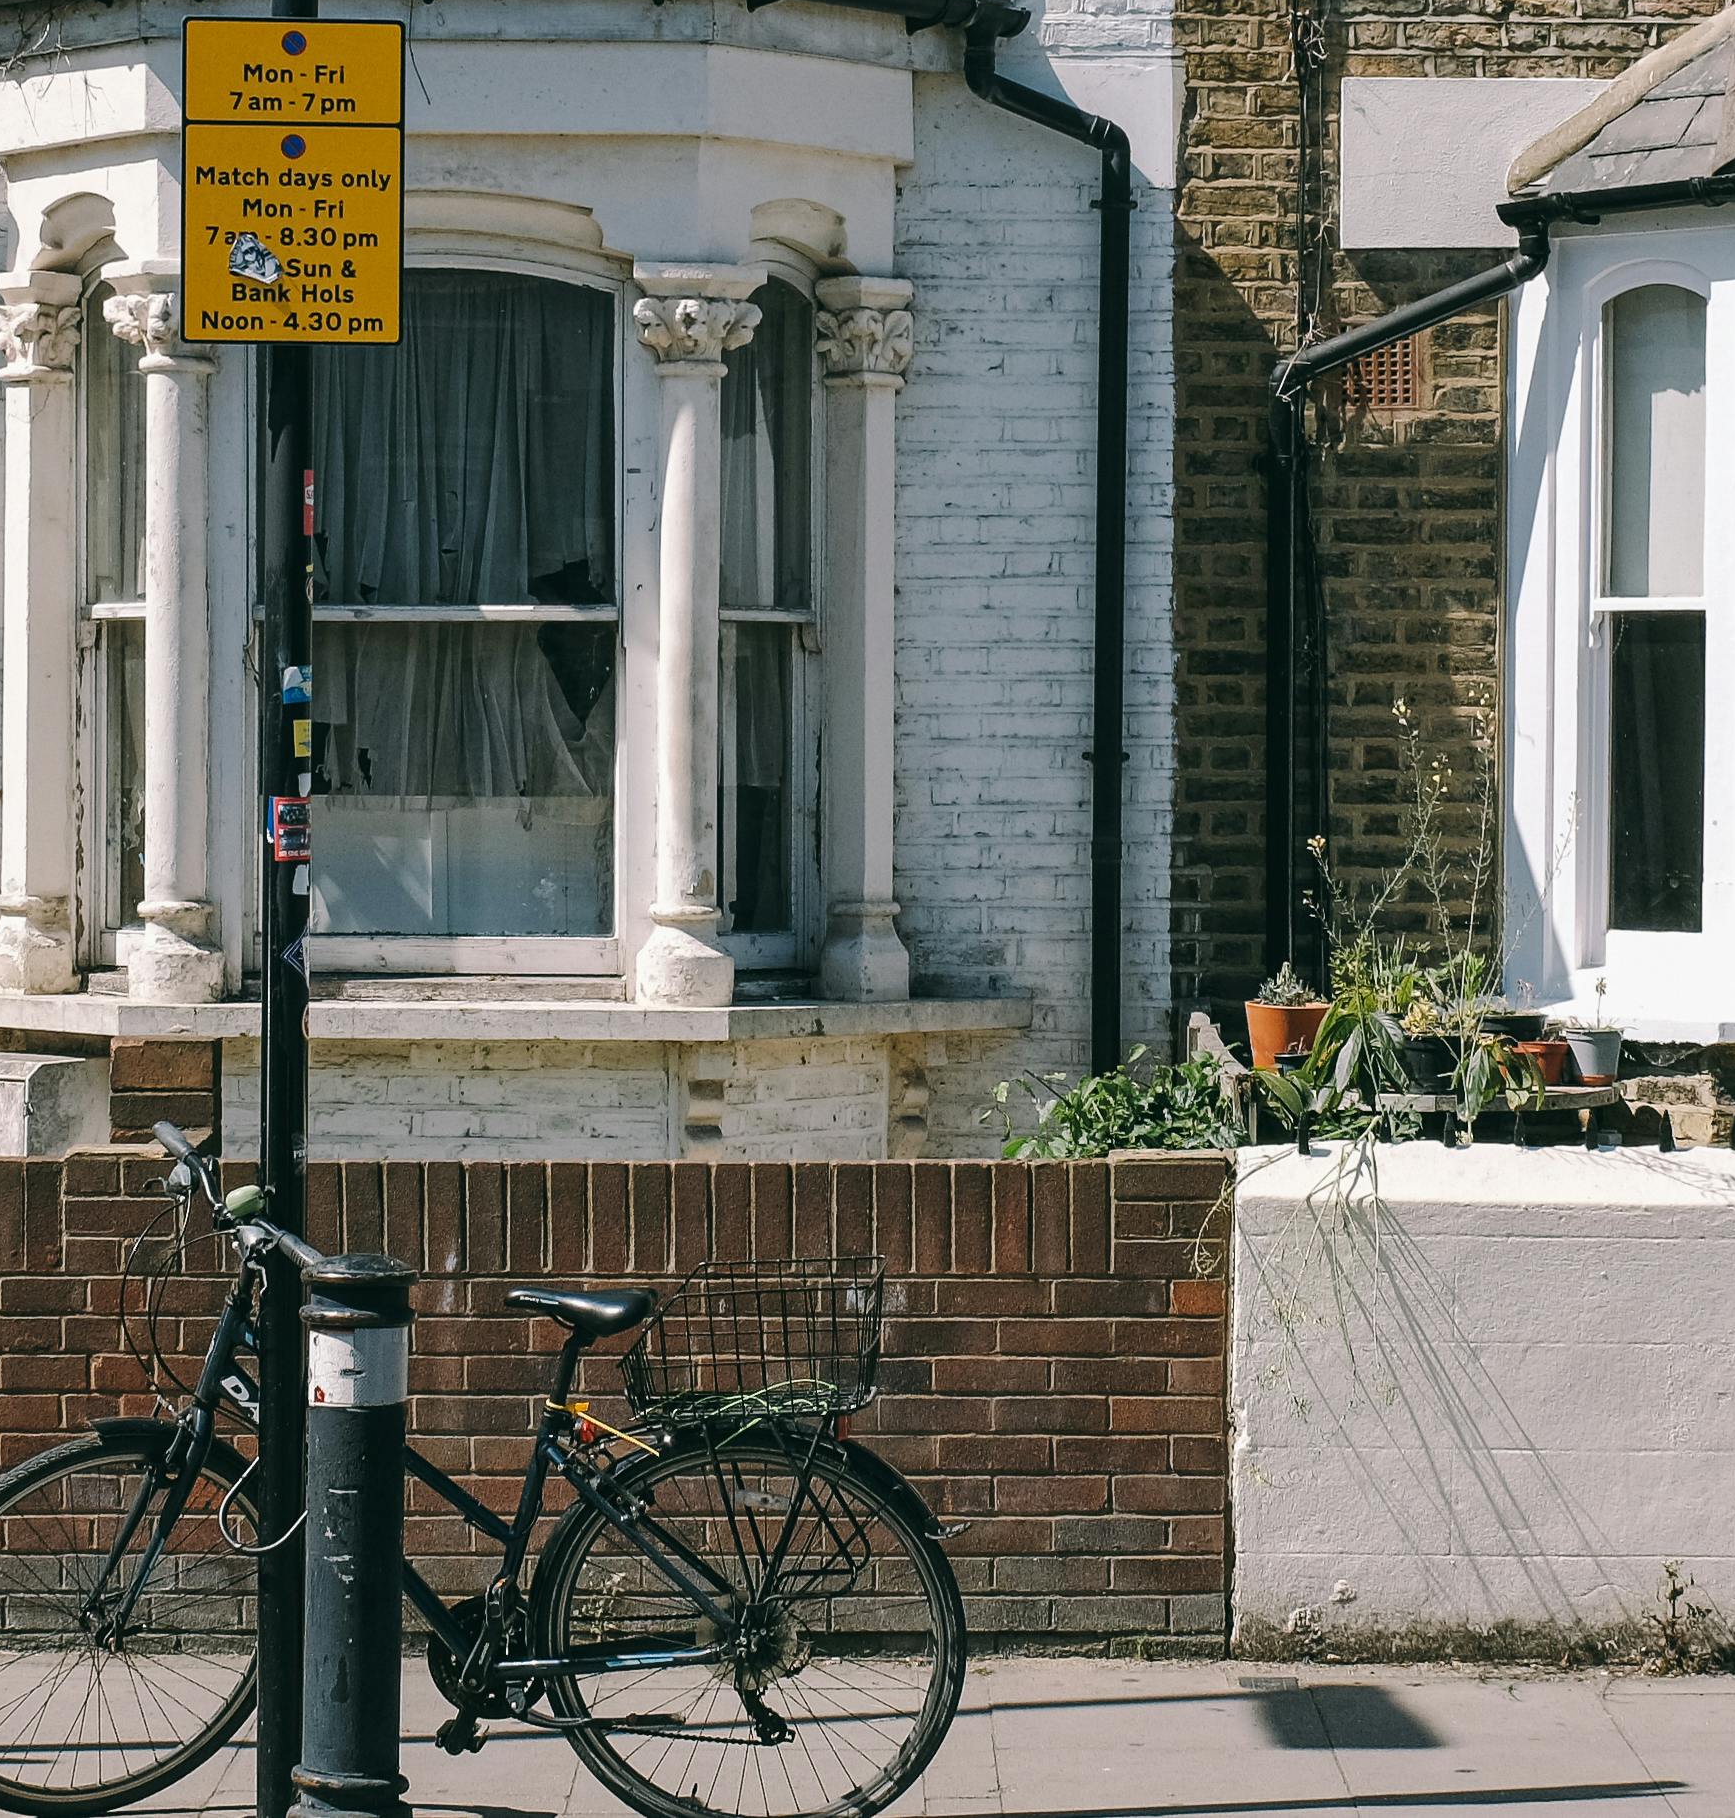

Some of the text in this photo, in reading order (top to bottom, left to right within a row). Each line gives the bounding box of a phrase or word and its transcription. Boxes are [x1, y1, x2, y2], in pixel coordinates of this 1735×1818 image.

[243, 64, 294, 83] Mon
[315, 65, 345, 84] Fri
[196, 165, 392, 191] Match days only
[242, 198, 293, 218] Mon
[314, 199, 345, 218] Fri
[279, 227, 336, 246] 8.30
[343, 231, 378, 250] pm
[286, 257, 332, 278] Sun
[341, 258, 357, 278] &
[232, 283, 354, 303] Bank Hols
[201, 310, 264, 331] Noon
[283, 312, 341, 332] 4.30
[348, 316, 383, 334] pm
